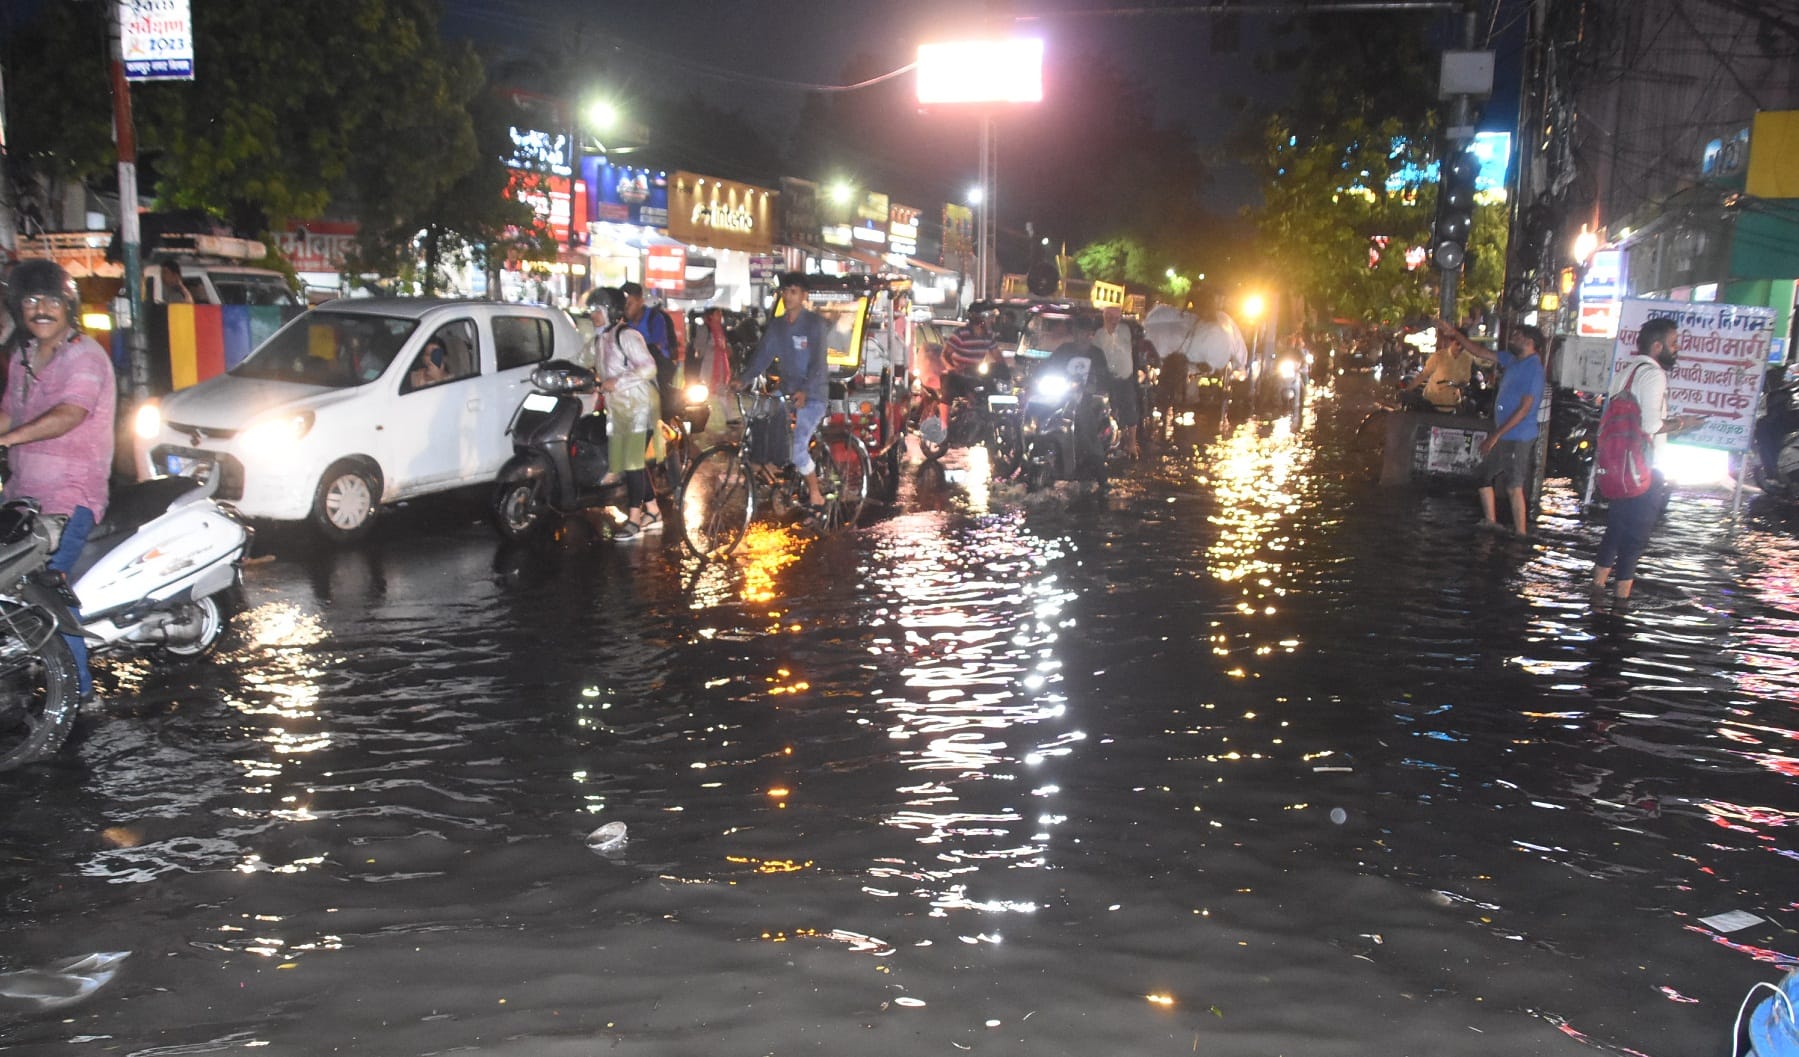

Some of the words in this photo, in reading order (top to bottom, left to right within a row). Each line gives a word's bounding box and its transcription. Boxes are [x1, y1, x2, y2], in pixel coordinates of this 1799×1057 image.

[150, 38, 184, 51] 2023
[1722, 334, 1767, 359] मार्ग
[1706, 388, 1753, 410] पार्क
